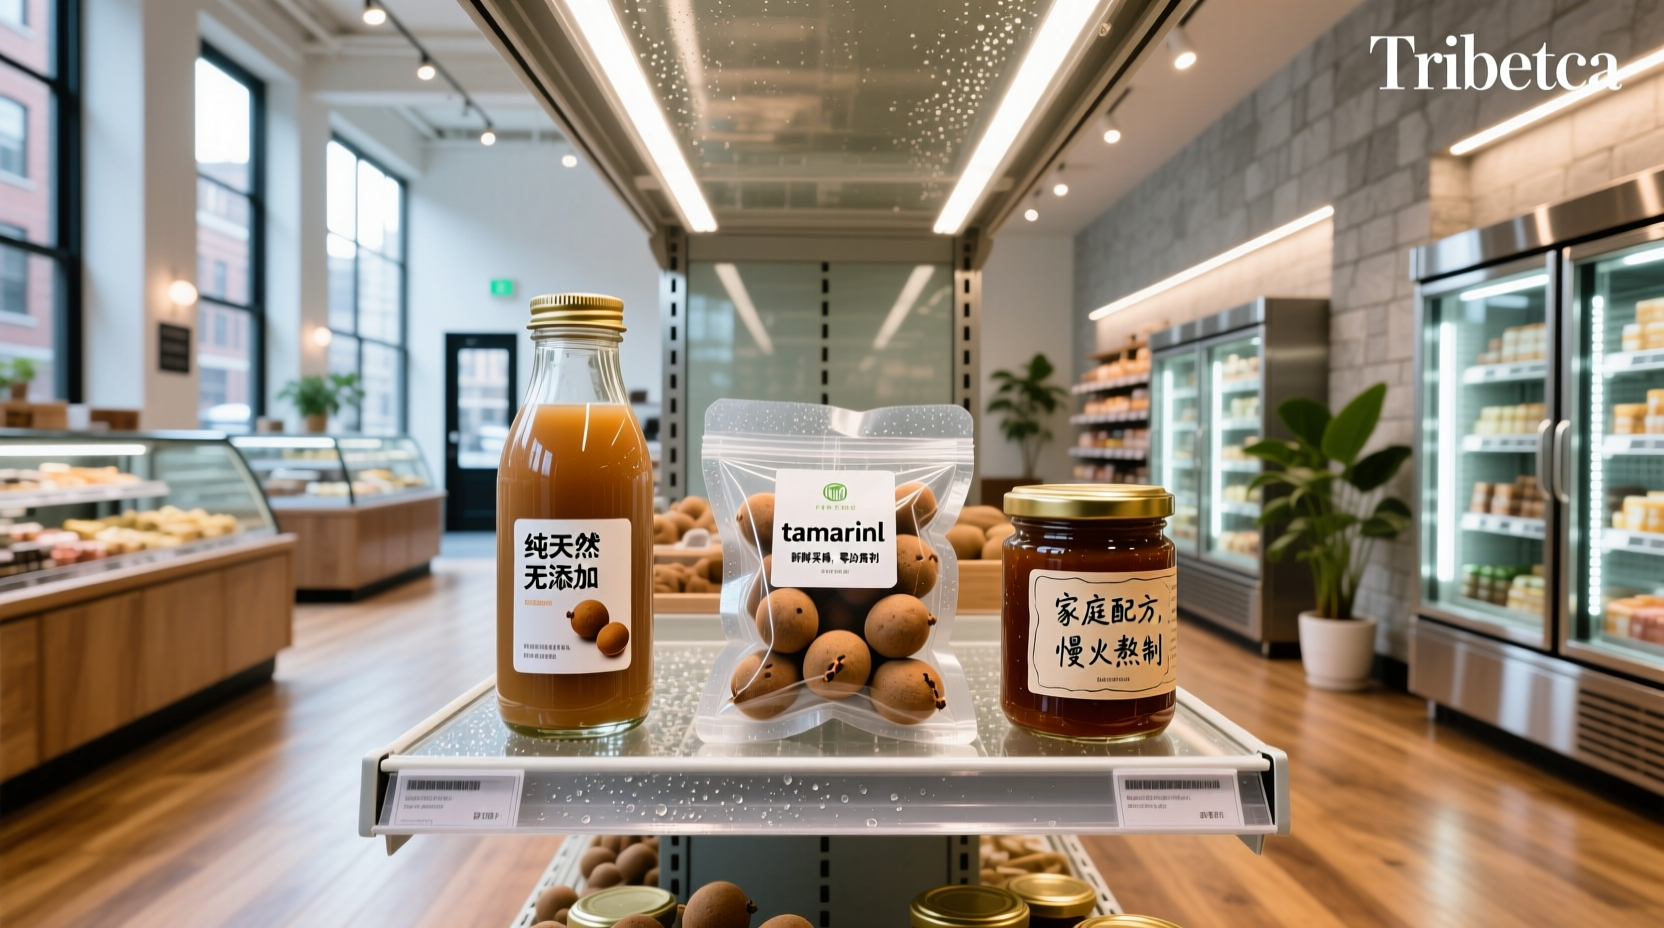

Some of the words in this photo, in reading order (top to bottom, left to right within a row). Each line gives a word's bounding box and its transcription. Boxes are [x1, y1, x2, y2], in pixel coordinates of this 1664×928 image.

[524, 531, 600, 560] 纯天然
[781, 520, 885, 543] tamarinl
[523, 563, 599, 591] 无添加
[1055, 633, 1162, 669] 慢火熬制
